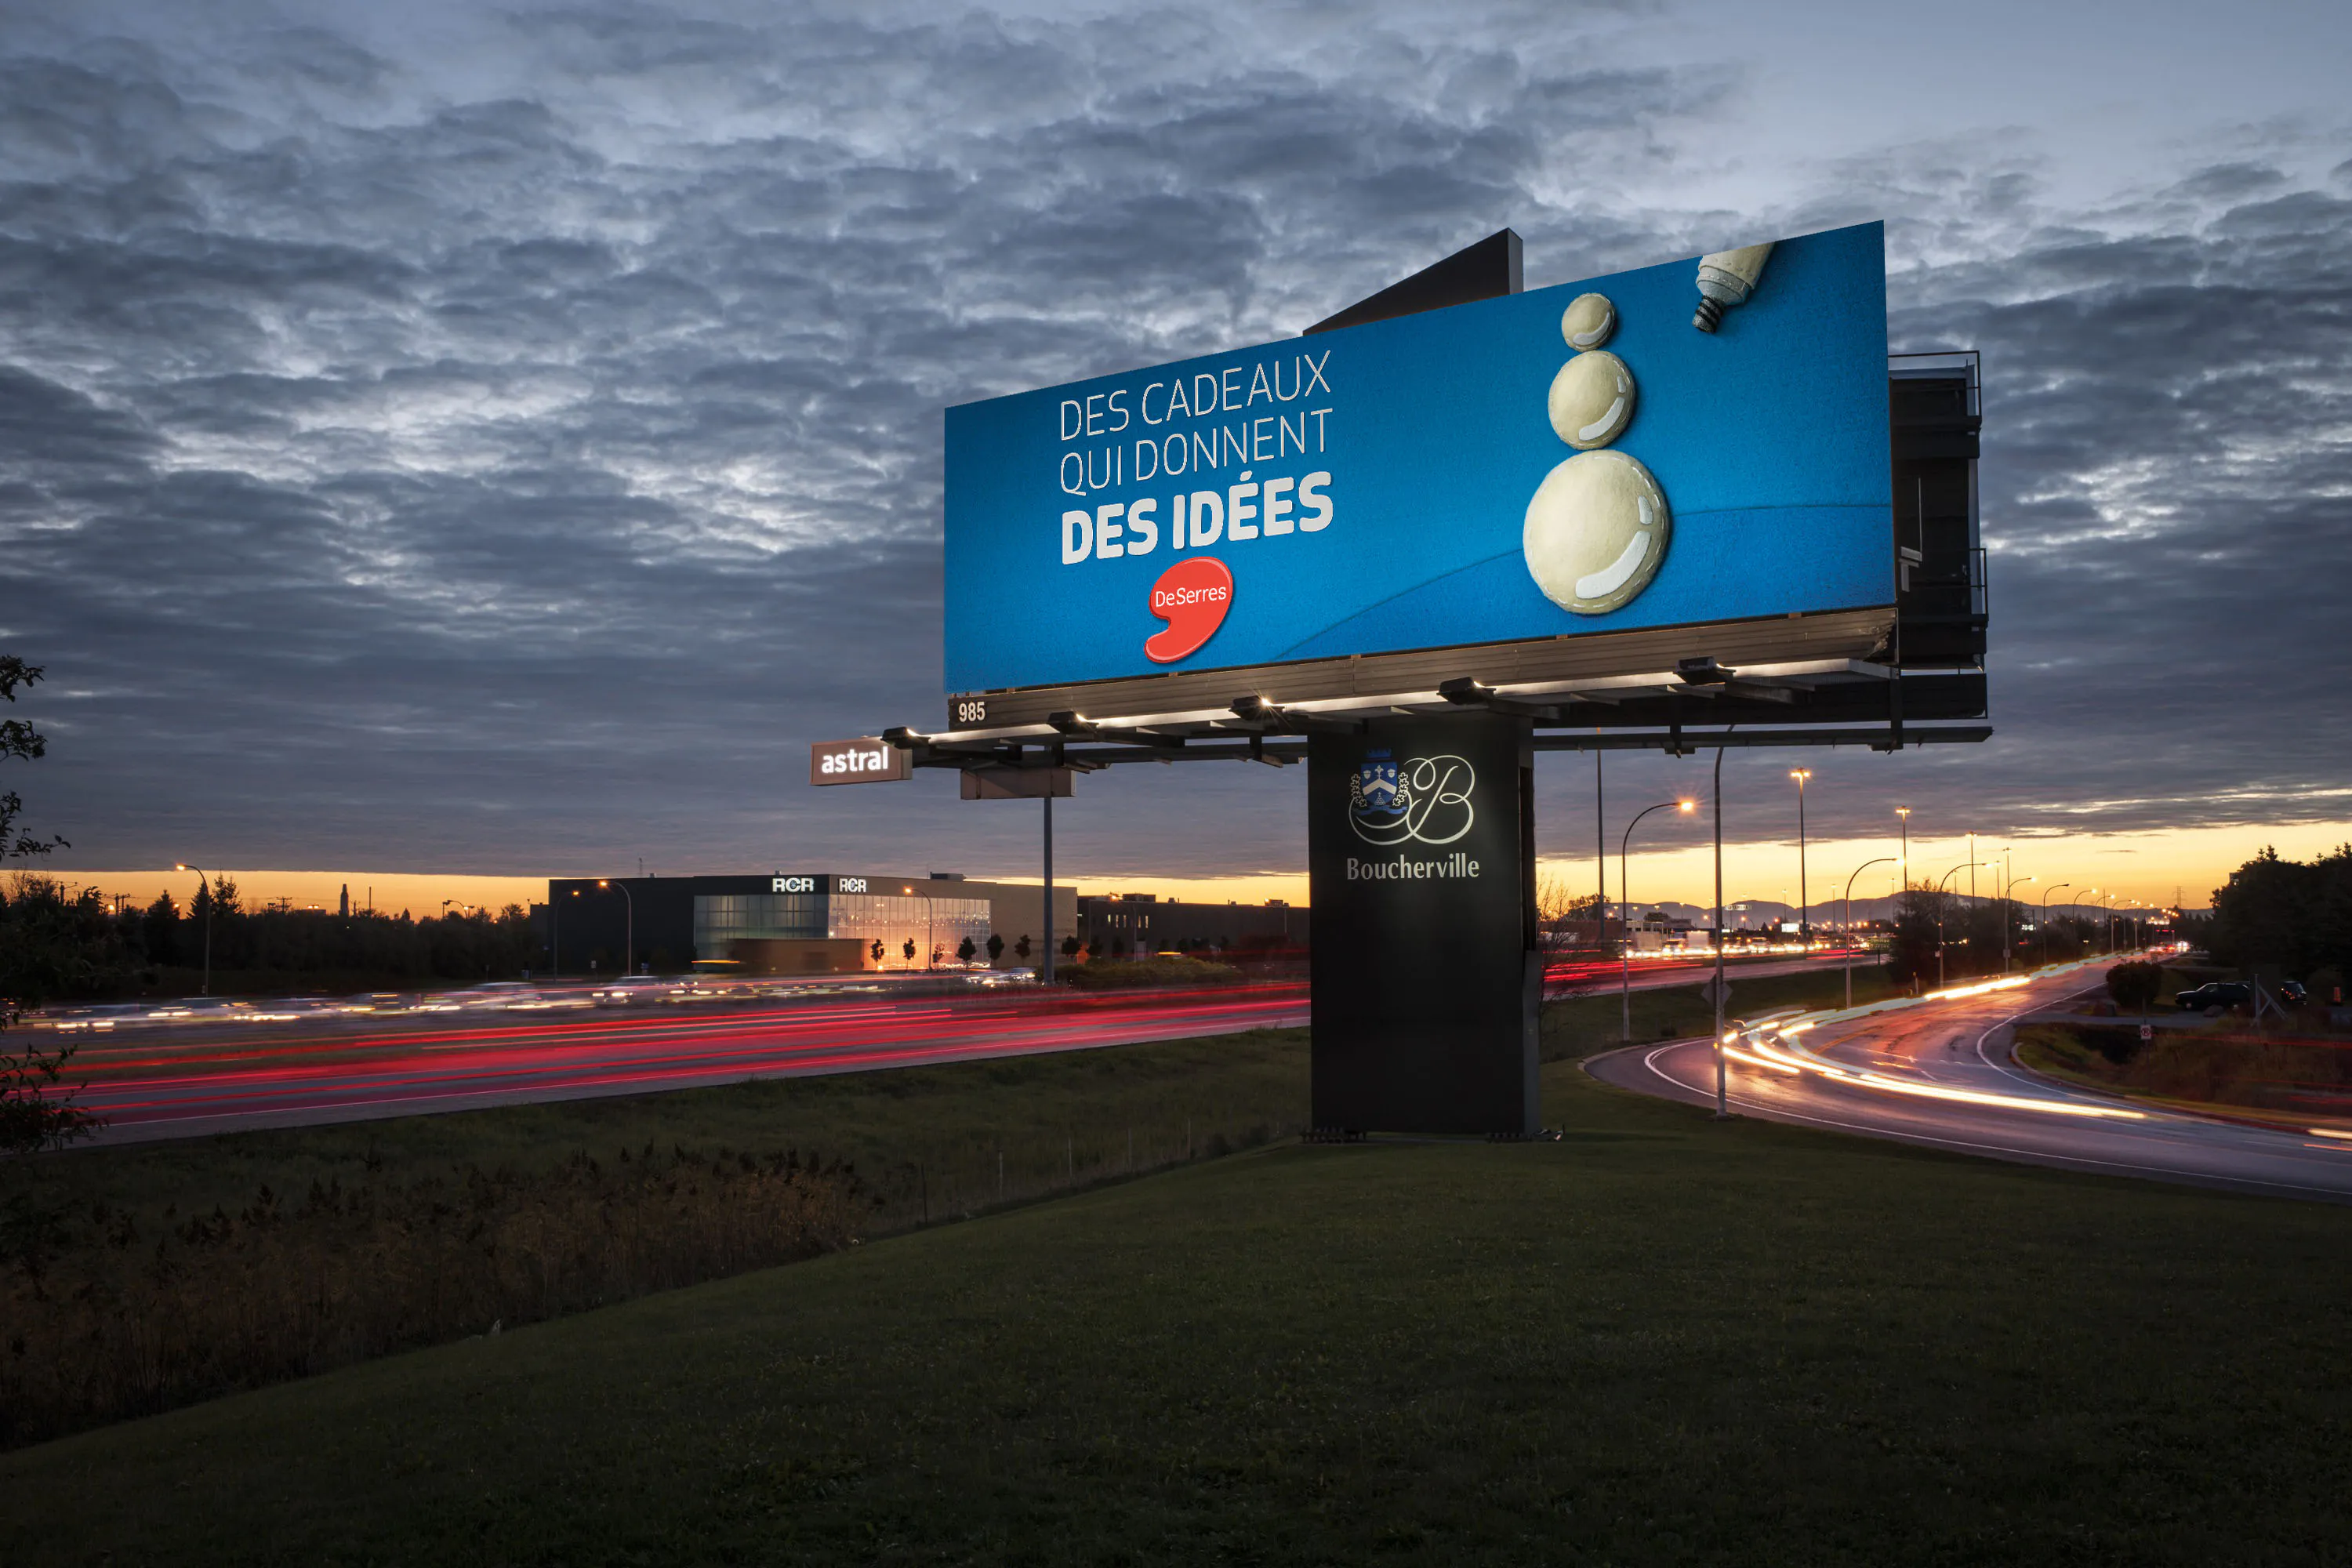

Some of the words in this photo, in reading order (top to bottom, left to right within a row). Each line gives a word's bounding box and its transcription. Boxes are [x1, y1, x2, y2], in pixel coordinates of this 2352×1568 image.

[1061, 390, 1129, 441] DES
[1142, 350, 1331, 425] CADEAUX
[1061, 445, 1122, 496] QUI
[1136, 408, 1334, 481] DONNENT
[1062, 498, 1159, 565] DES
[1173, 470, 1334, 550] IDÉES
[1156, 586, 1227, 607] DeSerres
[958, 701, 985, 721] 985
[822, 746, 888, 774] astral
[1347, 852, 1479, 880] Boucherville
[772, 877, 815, 892] RCR
[839, 877, 867, 892] RCR
